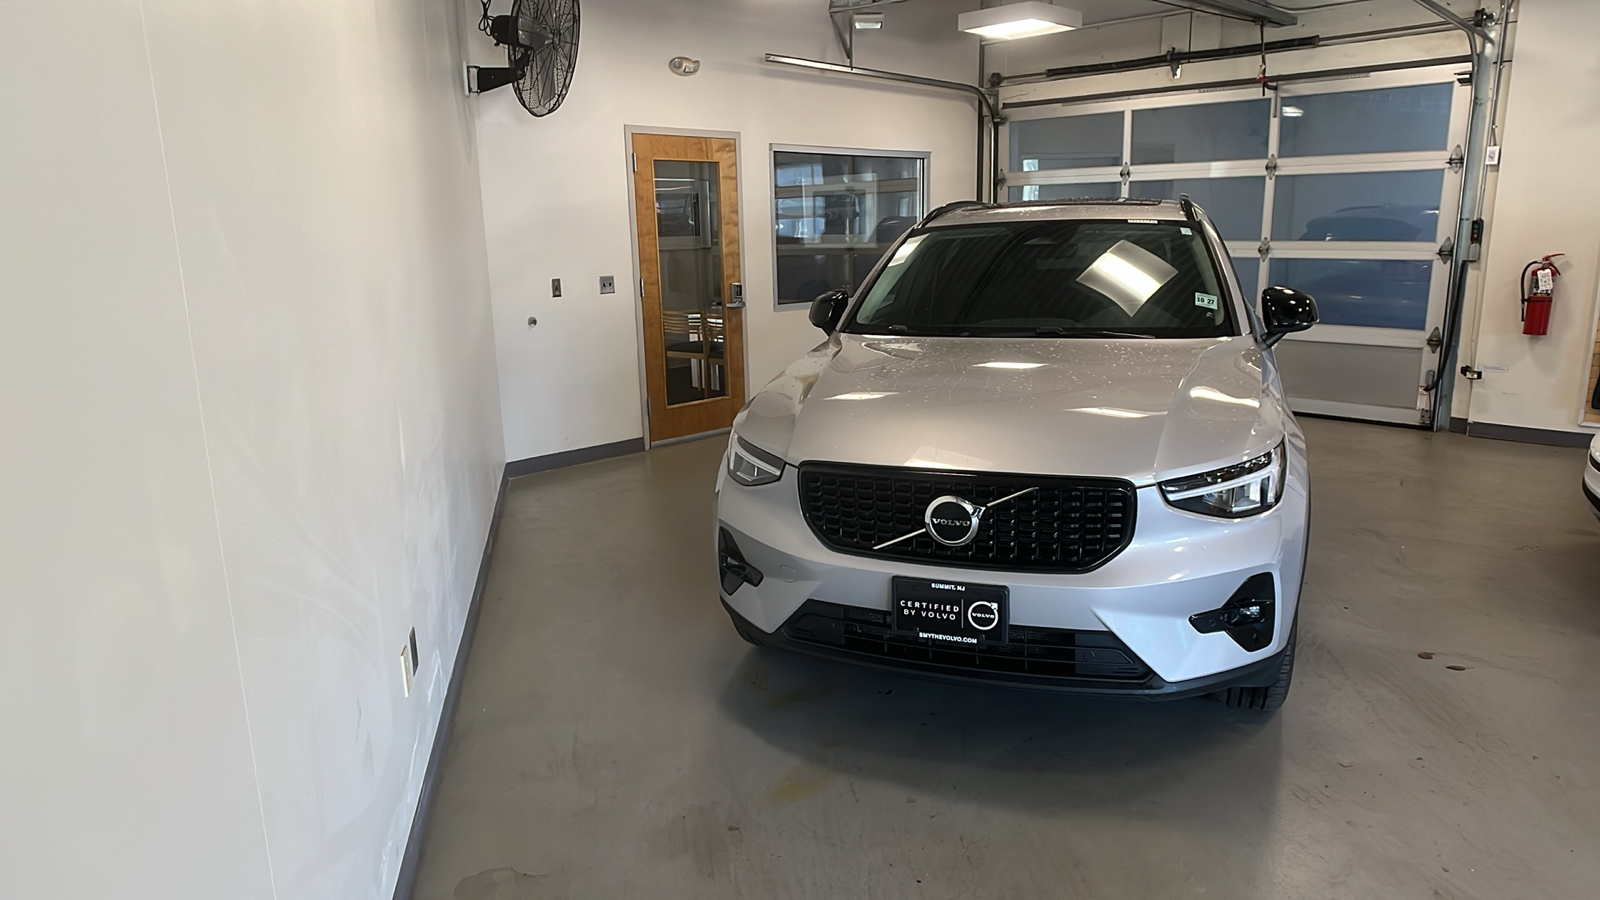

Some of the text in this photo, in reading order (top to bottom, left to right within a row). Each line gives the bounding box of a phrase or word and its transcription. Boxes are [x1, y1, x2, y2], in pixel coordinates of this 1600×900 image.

[932, 518, 970, 526] VOLVO
[900, 600, 959, 612] CERTIFIED
[921, 610, 956, 620] VOLVO
[919, 632, 978, 644] SMYTHEVOLVO.COM
